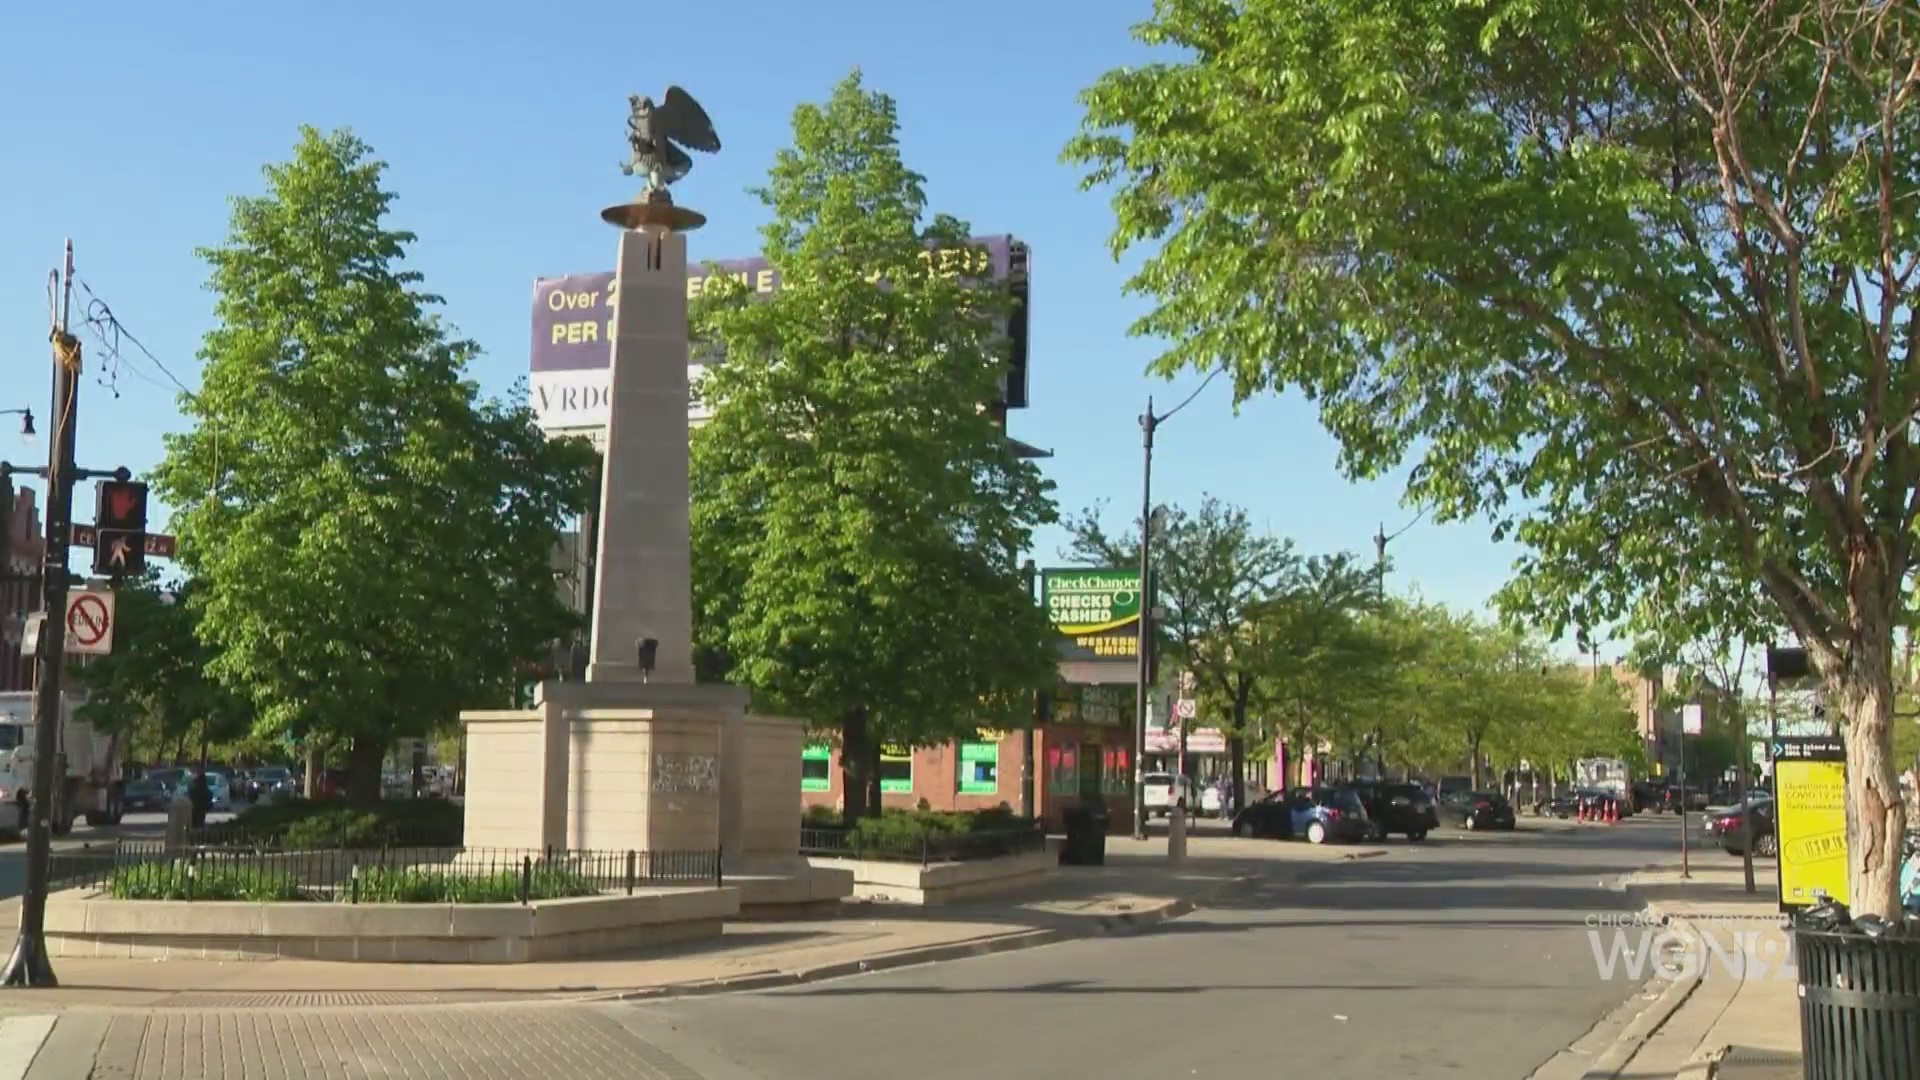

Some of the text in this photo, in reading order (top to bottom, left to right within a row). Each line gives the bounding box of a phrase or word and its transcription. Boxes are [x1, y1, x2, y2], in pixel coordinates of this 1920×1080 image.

[549, 289, 599, 311] Over
[551, 320, 598, 345] PER
[537, 383, 609, 411] VRD
[1049, 594, 1111, 609] CHECKS
[1048, 608, 1112, 623] CASHED
[1076, 636, 1136, 647] WESTERN
[1095, 645, 1136, 656] UNION
